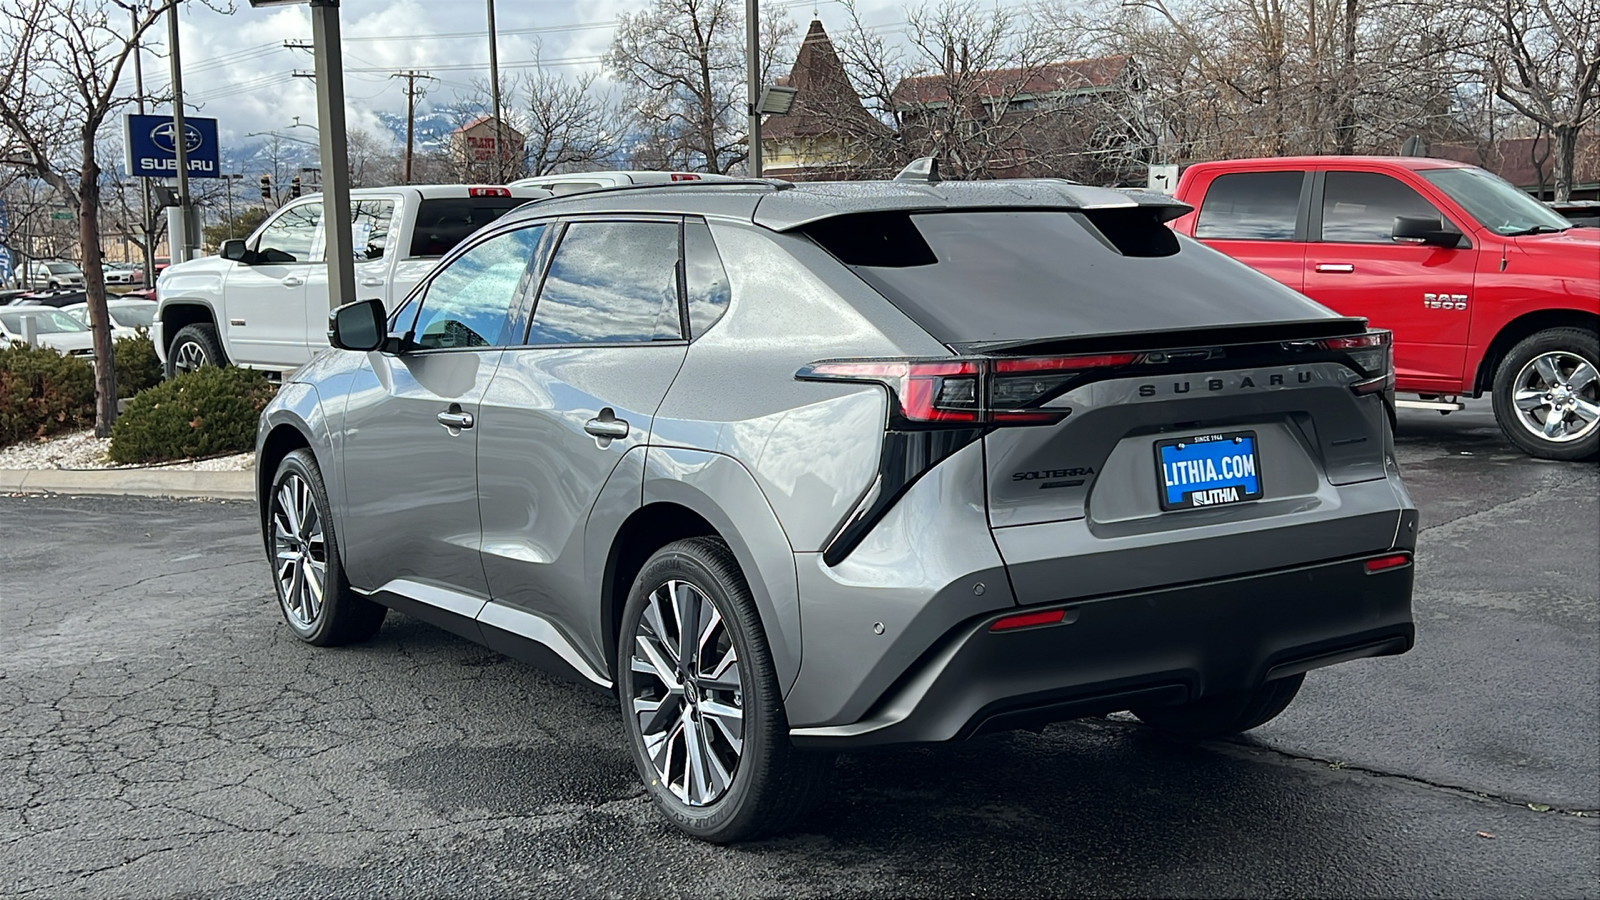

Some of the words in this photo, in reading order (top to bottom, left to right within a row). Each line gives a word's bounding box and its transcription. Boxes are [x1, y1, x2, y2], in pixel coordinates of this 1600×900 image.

[1424, 293, 1468, 302] RAM
[1424, 301, 1467, 310] 1500
[1138, 371, 1312, 397] SUBARU
[1194, 435, 1210, 443] SINCE
[1012, 467, 1095, 481] SOLTERRA
[1163, 454, 1255, 487] LITHIA.COM
[1203, 487, 1239, 505] LITHIA
